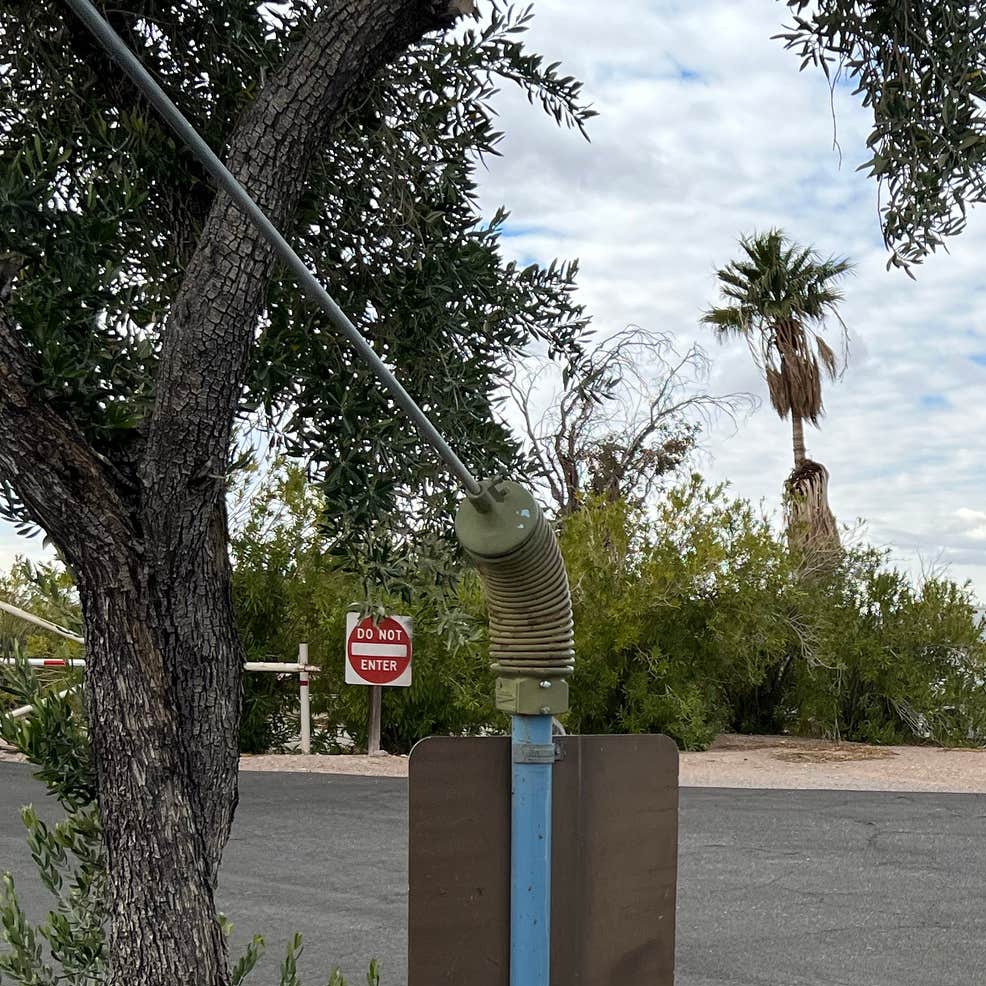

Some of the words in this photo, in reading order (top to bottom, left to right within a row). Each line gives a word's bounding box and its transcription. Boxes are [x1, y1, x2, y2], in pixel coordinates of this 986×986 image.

[357, 628, 373, 640] DO
[379, 629, 402, 641] NOT
[361, 659, 398, 671] ENTER
